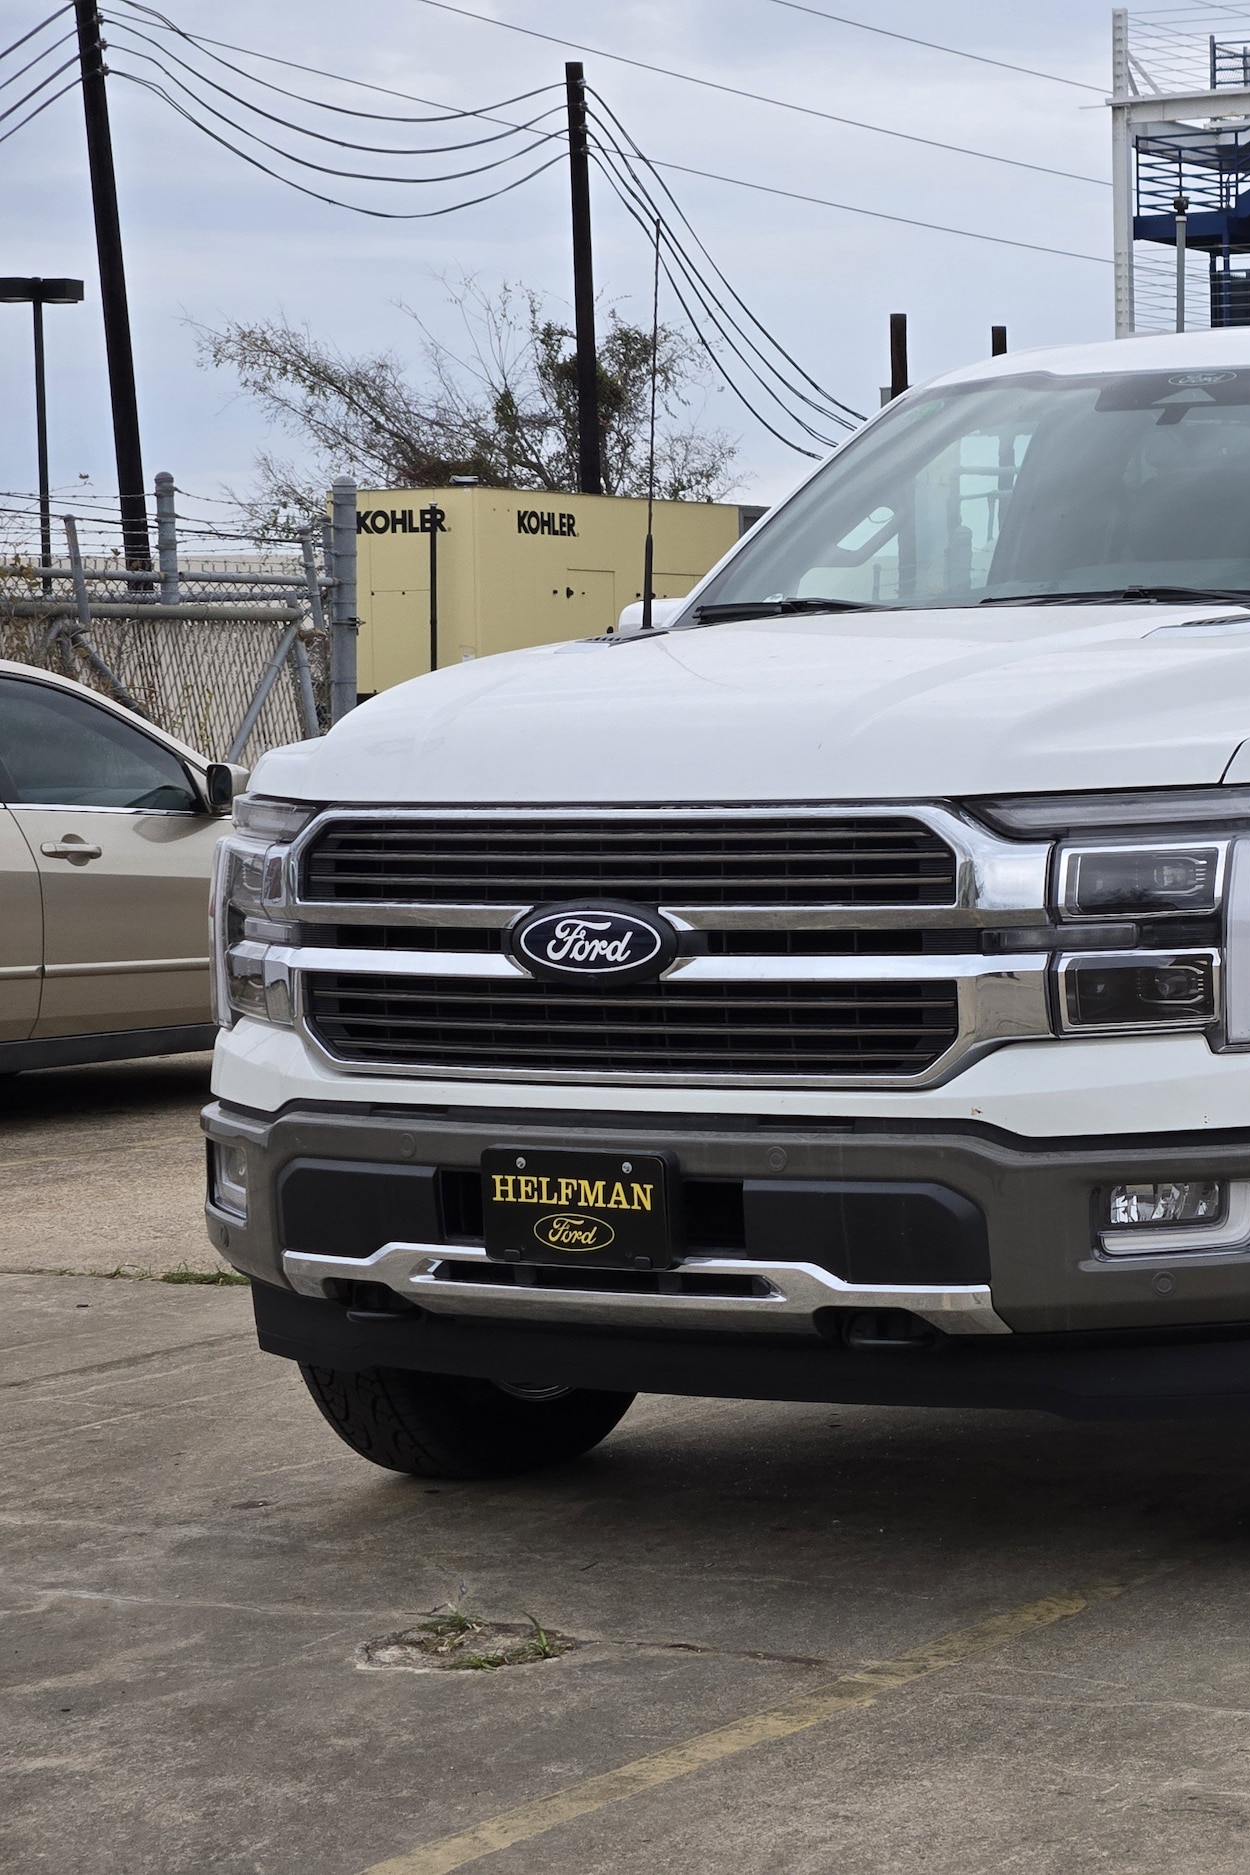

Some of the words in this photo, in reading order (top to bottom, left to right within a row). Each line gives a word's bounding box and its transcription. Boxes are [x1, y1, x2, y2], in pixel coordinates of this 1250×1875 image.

[356, 509, 447, 534] KOHLER
[517, 510, 578, 537] KOHLER
[546, 918, 634, 963] Ford
[491, 1174, 654, 1211] HELFMAN
[548, 1217, 598, 1245] Ford
